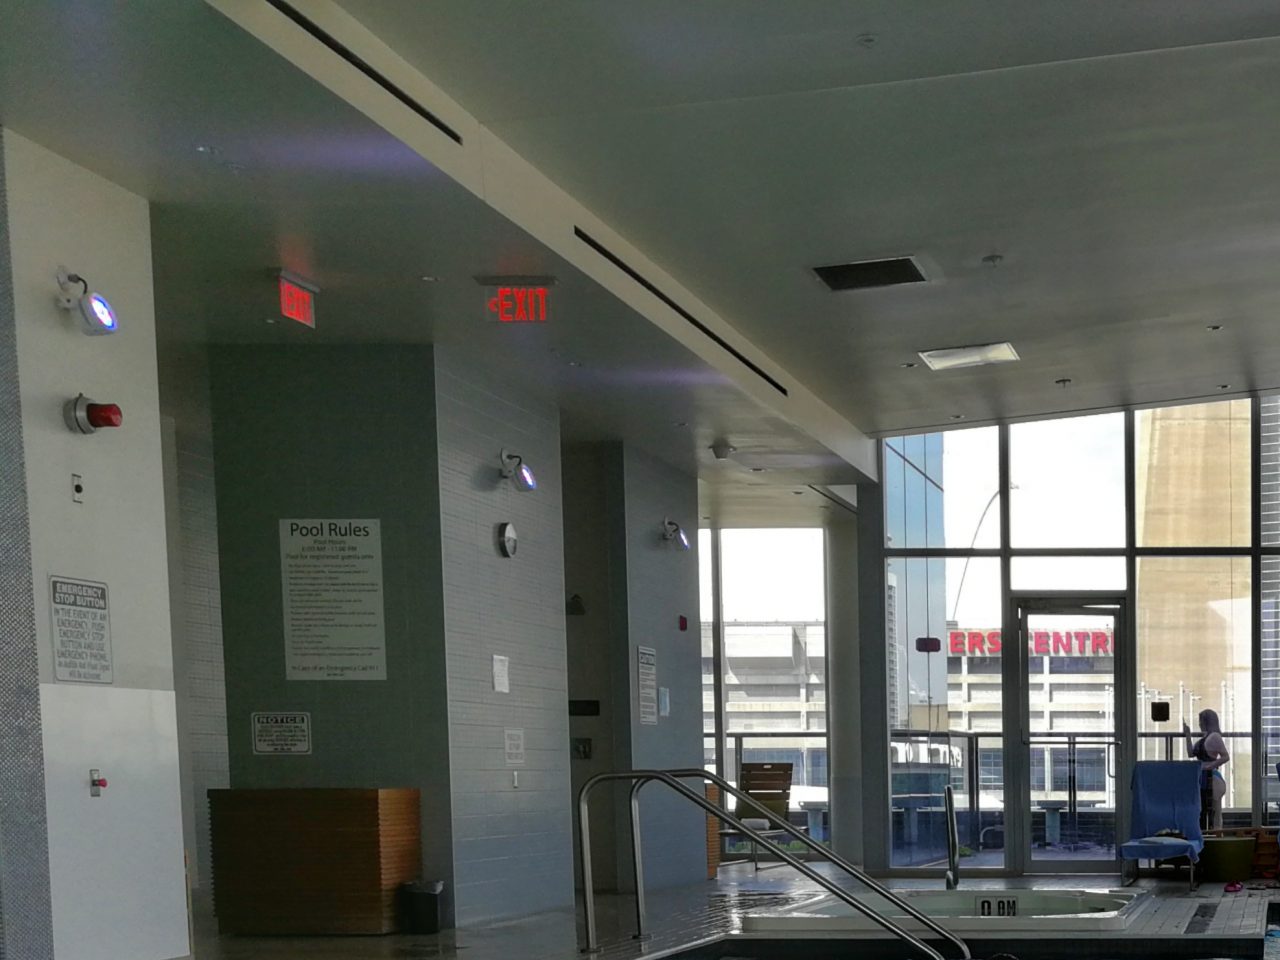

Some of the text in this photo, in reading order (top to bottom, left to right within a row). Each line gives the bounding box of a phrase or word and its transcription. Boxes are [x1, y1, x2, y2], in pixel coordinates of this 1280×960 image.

[499, 287, 547, 321] EXIT
[290, 521, 370, 537] Pool Rules
[56, 583, 103, 598] EMERGENCY
[55, 593, 105, 608] STOP BUTTON
[1029, 631, 1114, 655] ENTR
[259, 716, 302, 724] NOTICE
